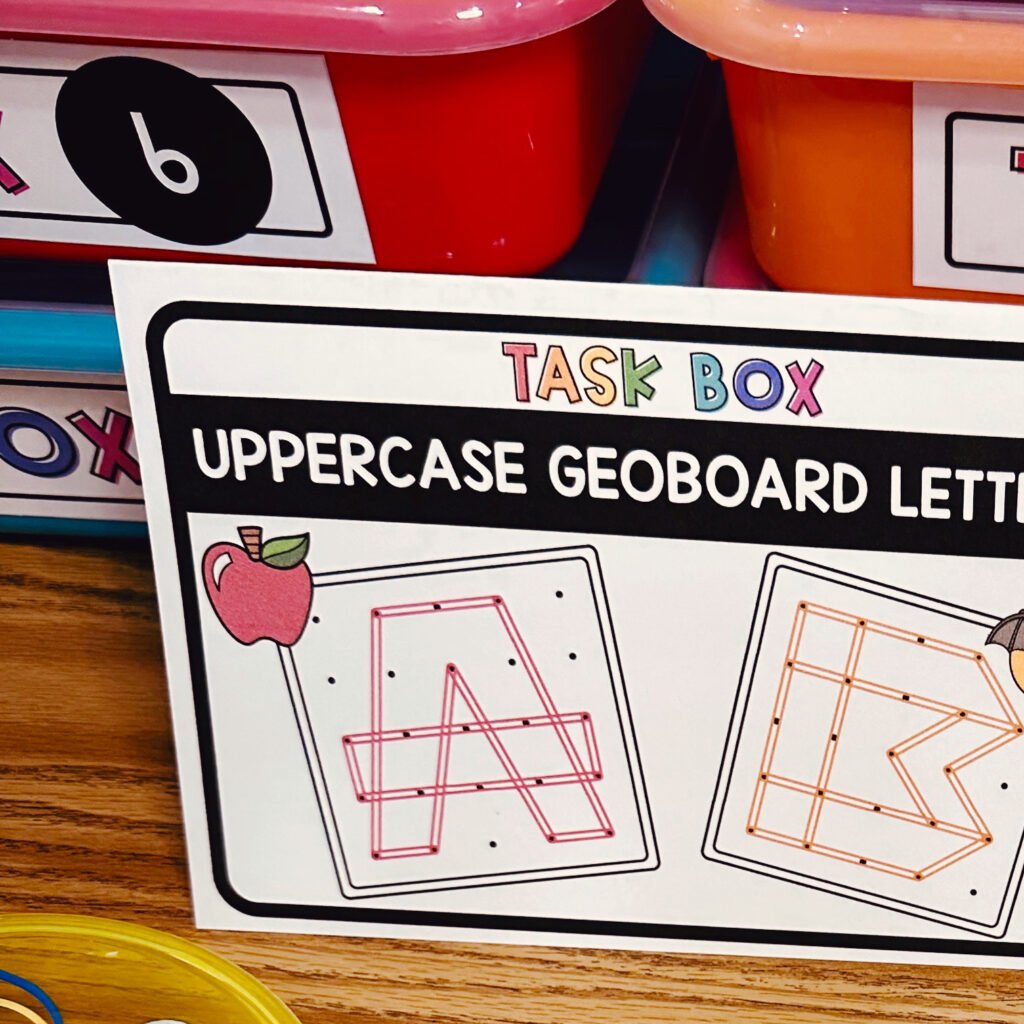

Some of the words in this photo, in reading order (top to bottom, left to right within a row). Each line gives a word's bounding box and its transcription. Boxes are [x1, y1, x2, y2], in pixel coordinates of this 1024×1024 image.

[130, 111, 200, 195] 6
[502, 342, 662, 407] TASK
[690, 352, 824, 417] BOX
[192, 428, 527, 494] UPPERCASE
[549, 445, 869, 514] GEOBOARD
